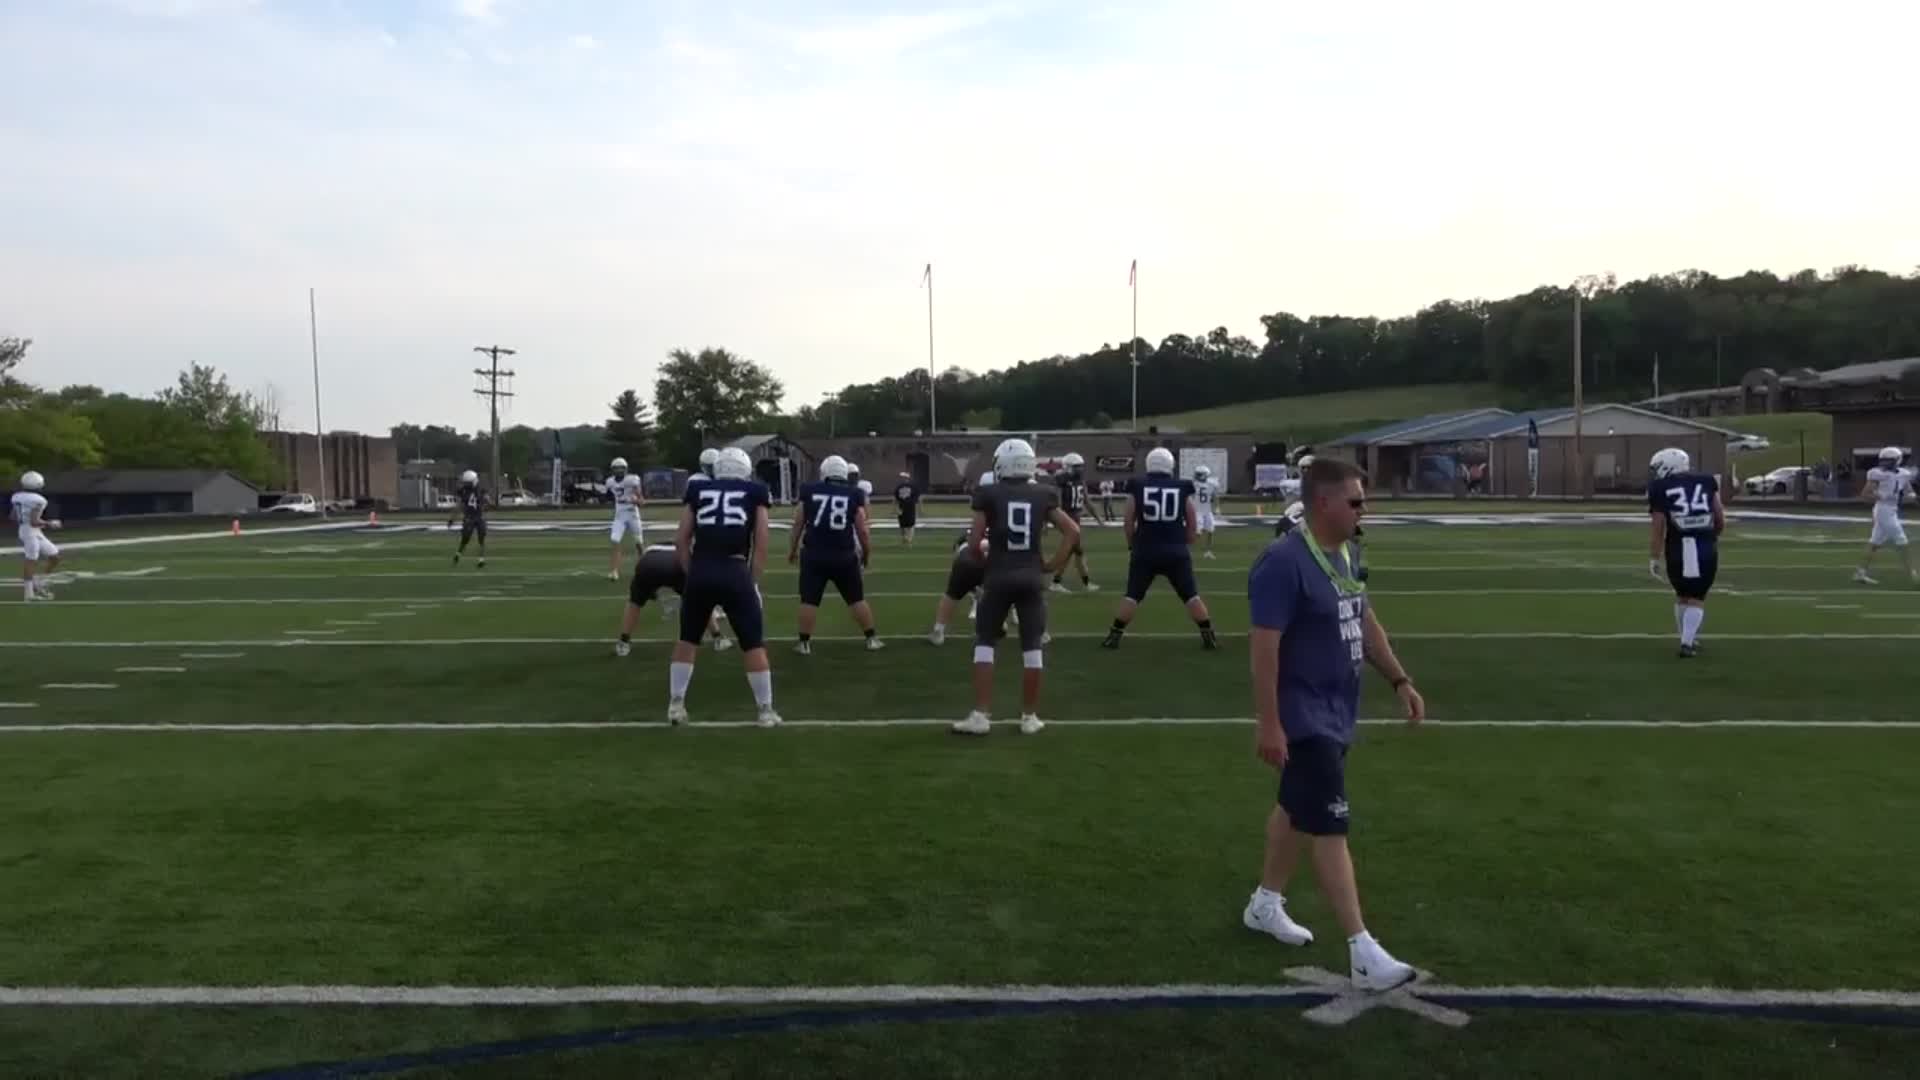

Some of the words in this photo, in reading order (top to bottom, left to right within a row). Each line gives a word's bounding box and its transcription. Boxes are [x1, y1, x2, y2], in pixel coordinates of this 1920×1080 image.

[467, 493, 477, 510] 4
[697, 490, 747, 525] 25
[812, 494, 849, 529] 78
[1143, 487, 1180, 521] 50
[1666, 484, 1709, 516] 34
[1008, 501, 1031, 550] 9
